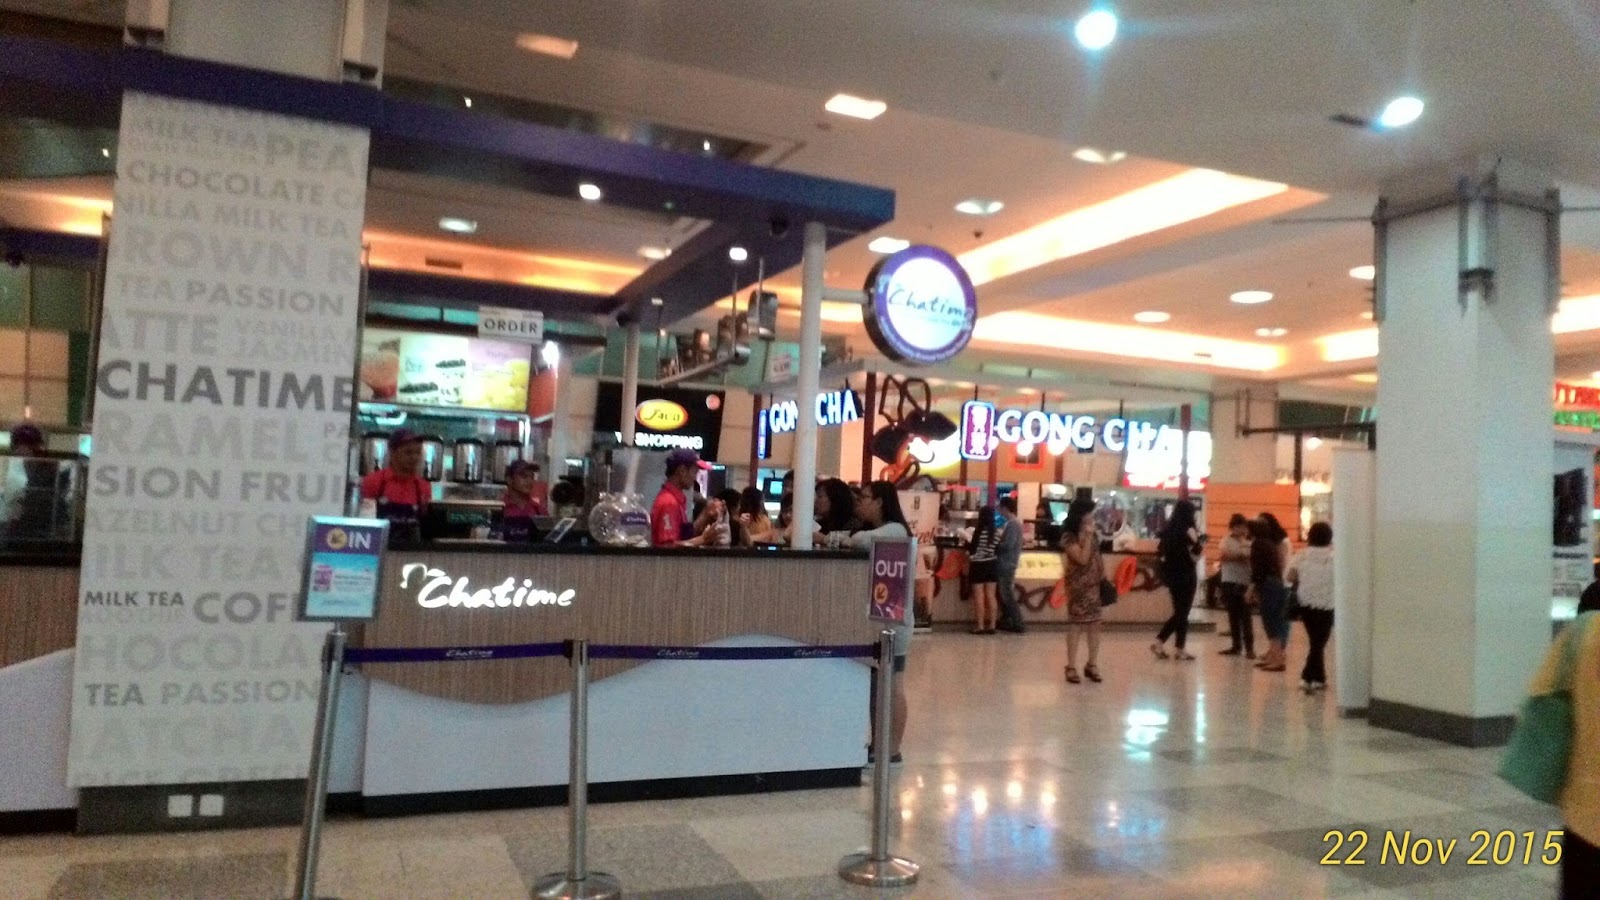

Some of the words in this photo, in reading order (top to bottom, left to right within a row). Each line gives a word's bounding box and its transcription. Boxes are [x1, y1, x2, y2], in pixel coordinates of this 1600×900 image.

[125, 159, 325, 206] CHOCOLATE
[212, 204, 288, 232] MILK
[299, 214, 350, 241] TEA
[124, 226, 307, 279] ROWN
[117, 274, 174, 300] TEA
[186, 280, 344, 317] PASSION
[888, 286, 975, 321] Chatime
[484, 318, 538, 334] ORDER
[97, 359, 354, 412] CHATIME
[814, 390, 858, 426] CHA
[97, 410, 308, 463] RAMEL
[635, 432, 704, 450] SHOPPING
[997, 409, 1096, 449] GONG
[1103, 418, 1177, 453] CHA
[93, 464, 221, 501] SION
[348, 531, 371, 549] IN
[192, 544, 282, 581] TEA
[875, 559, 907, 578] OUT
[85, 591, 139, 606] MILK
[147, 591, 185, 606] TEA
[417, 575, 576, 609] Chatime
[84, 681, 146, 707] TEA
[161, 679, 316, 706] PASSION
